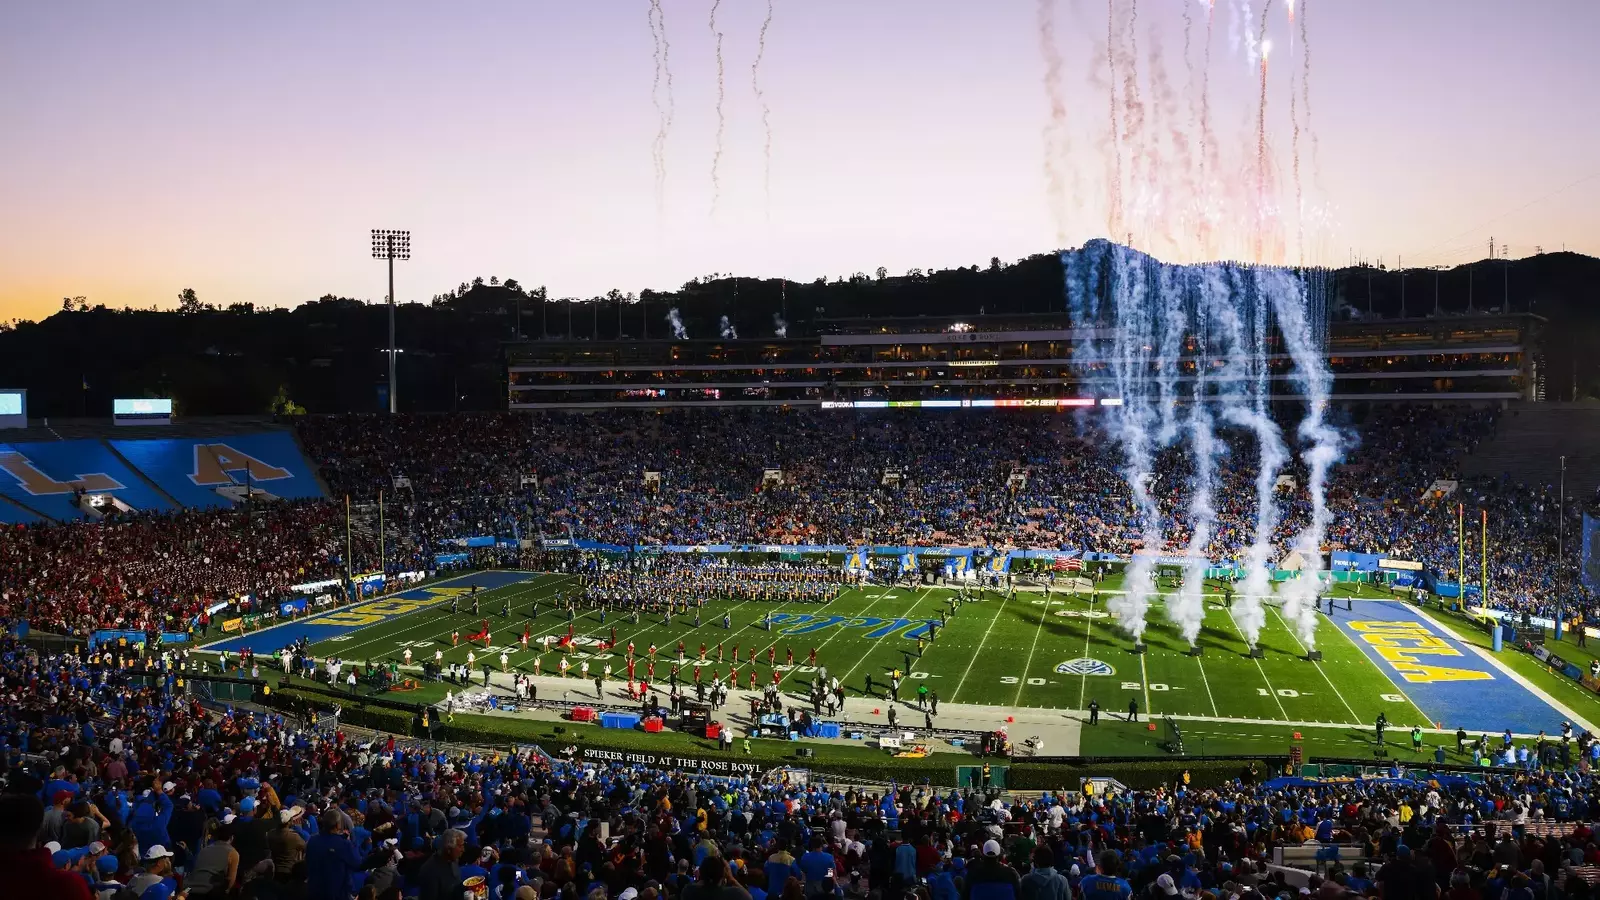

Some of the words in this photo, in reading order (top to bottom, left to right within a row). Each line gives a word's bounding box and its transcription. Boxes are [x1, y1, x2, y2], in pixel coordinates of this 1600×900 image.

[1346, 619, 1496, 684] UCLA
[1000, 676, 1047, 685] 30
[1121, 681, 1169, 691] 20
[1257, 688, 1299, 697] 10
[584, 749, 623, 761] SPIEKER
[627, 753, 655, 764] FIELD
[659, 757, 671, 766] AT
[676, 758, 698, 768] THE
[701, 760, 728, 771] ROSE
[731, 762, 762, 773] BOWL
